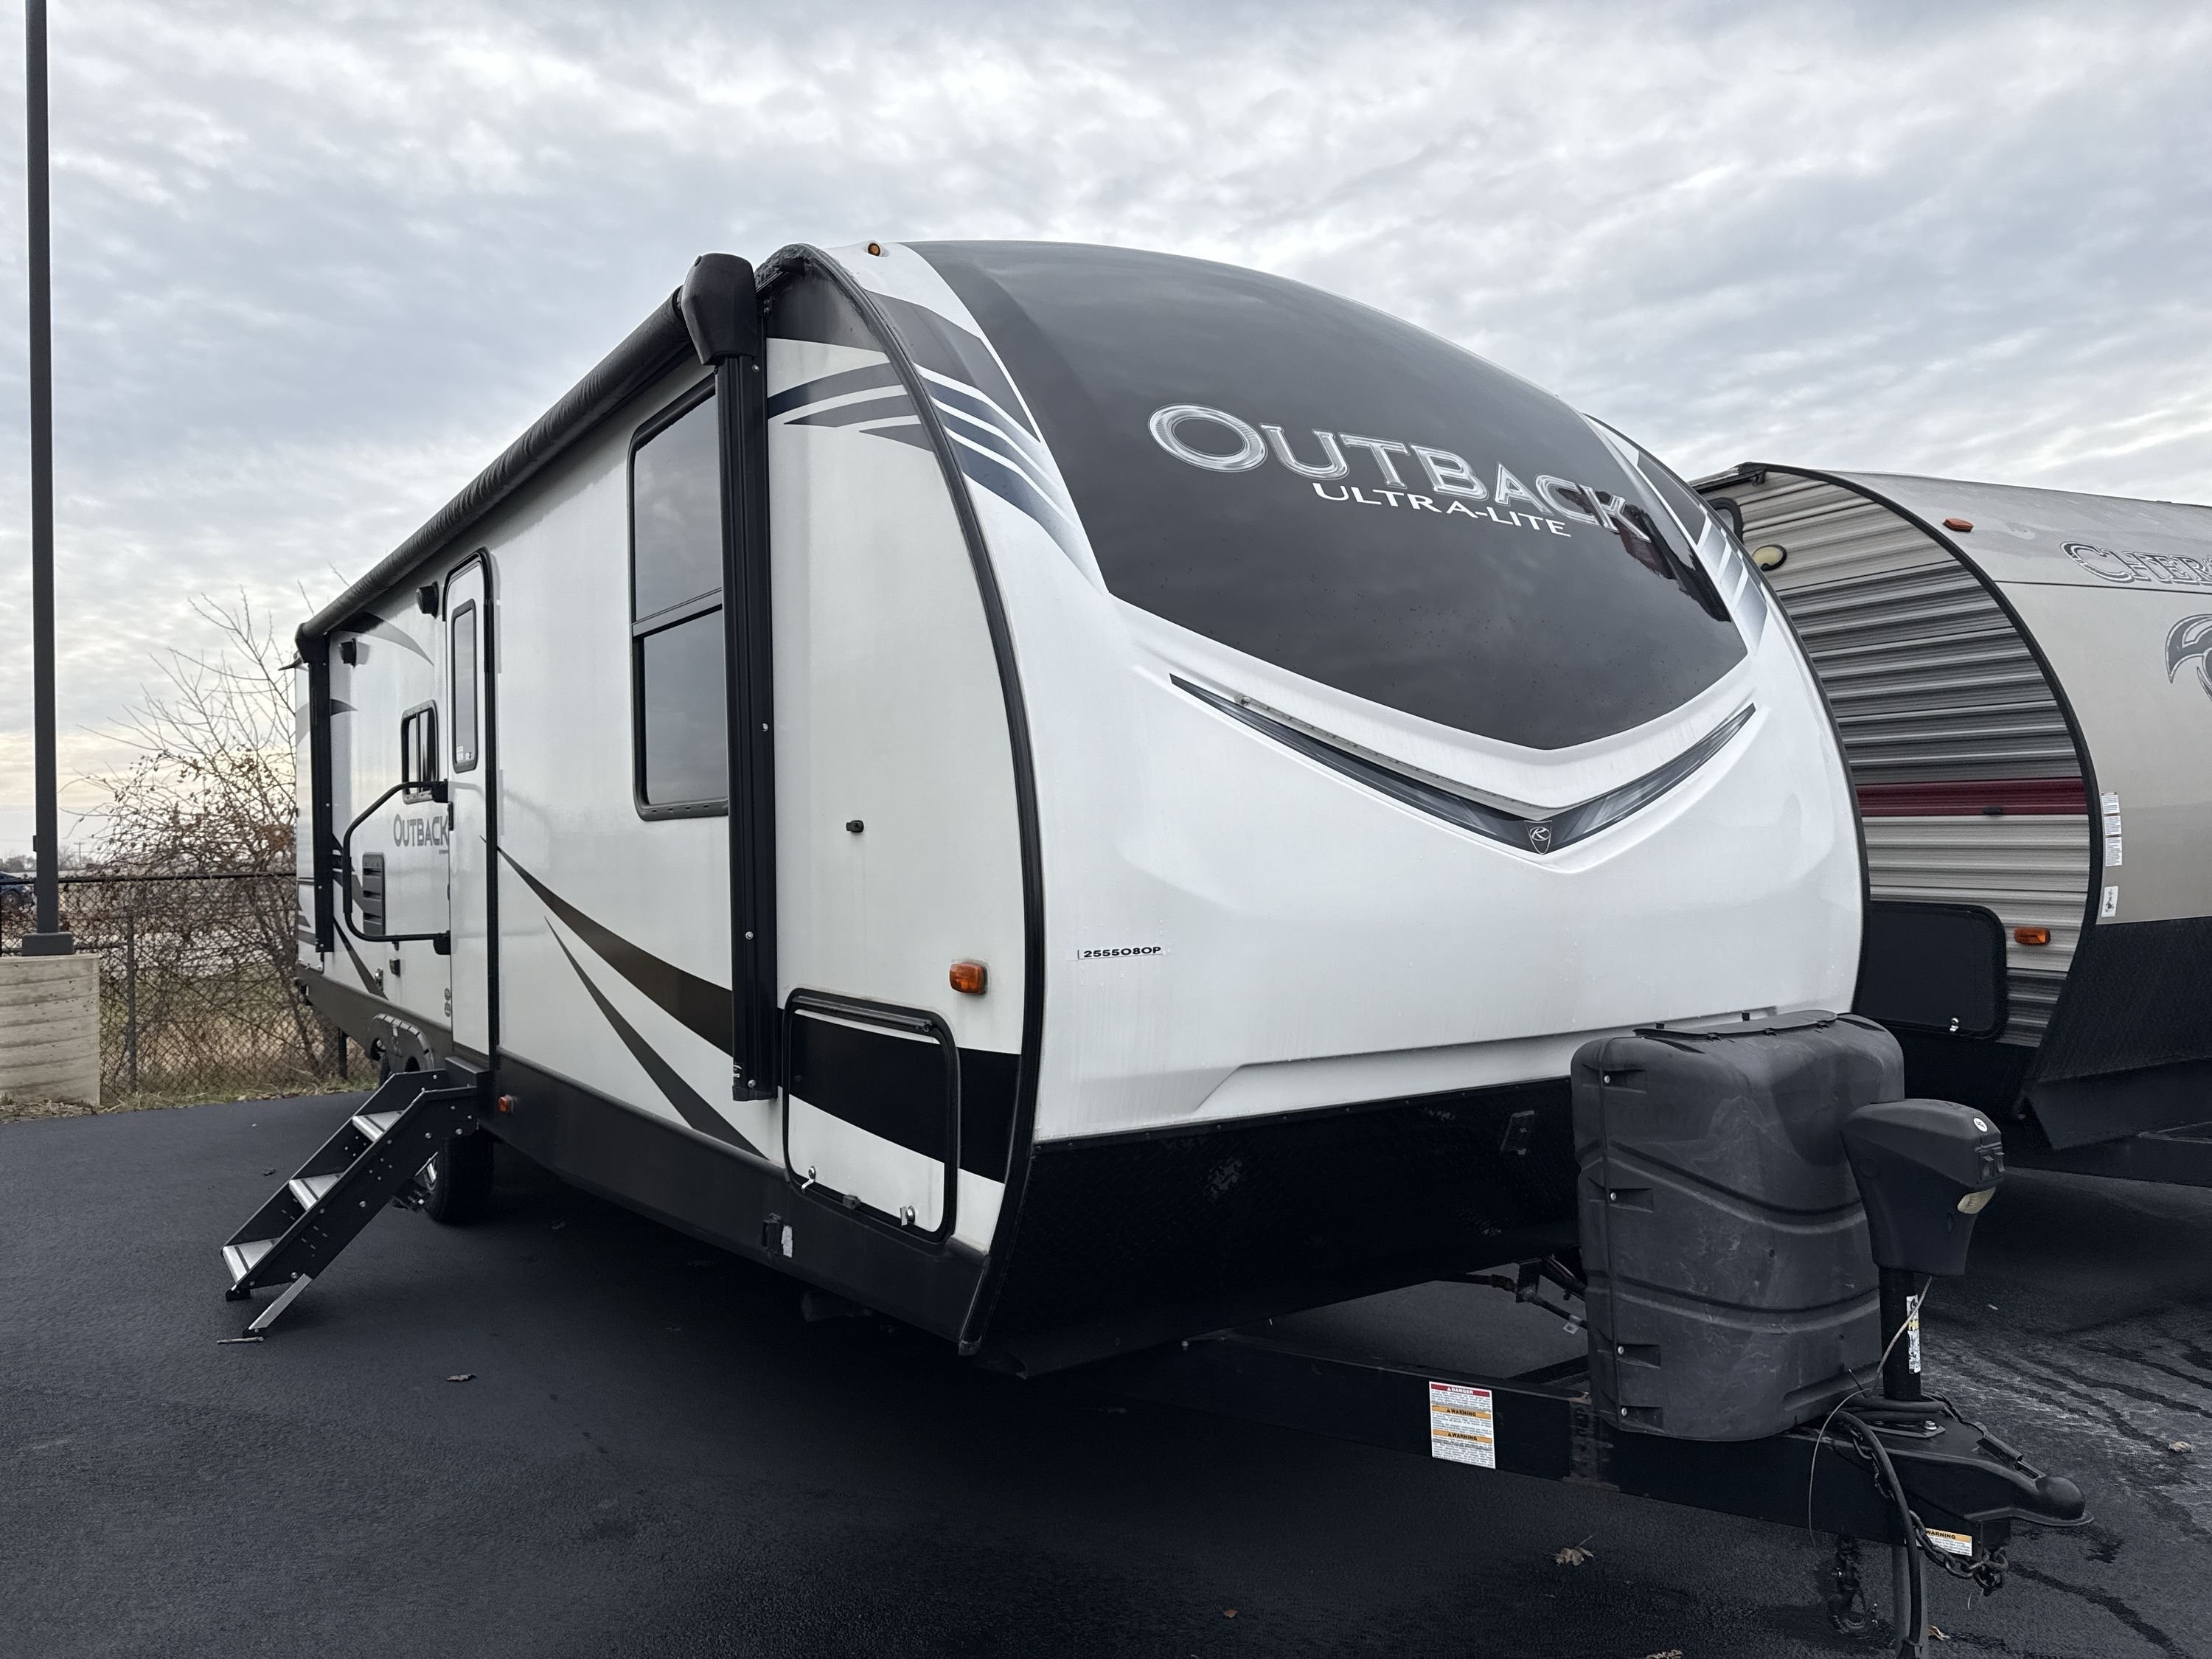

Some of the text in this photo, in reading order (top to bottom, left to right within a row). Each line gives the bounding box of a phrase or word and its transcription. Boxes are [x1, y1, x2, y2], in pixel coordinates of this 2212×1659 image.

[1148, 403, 1652, 543] OUTBACK
[1312, 483, 1571, 537] ULTRA-LITE
[2060, 541, 2212, 585] CHER
[393, 813, 448, 847] OUTBACK
[1926, 1530, 1956, 1540] WARNING
